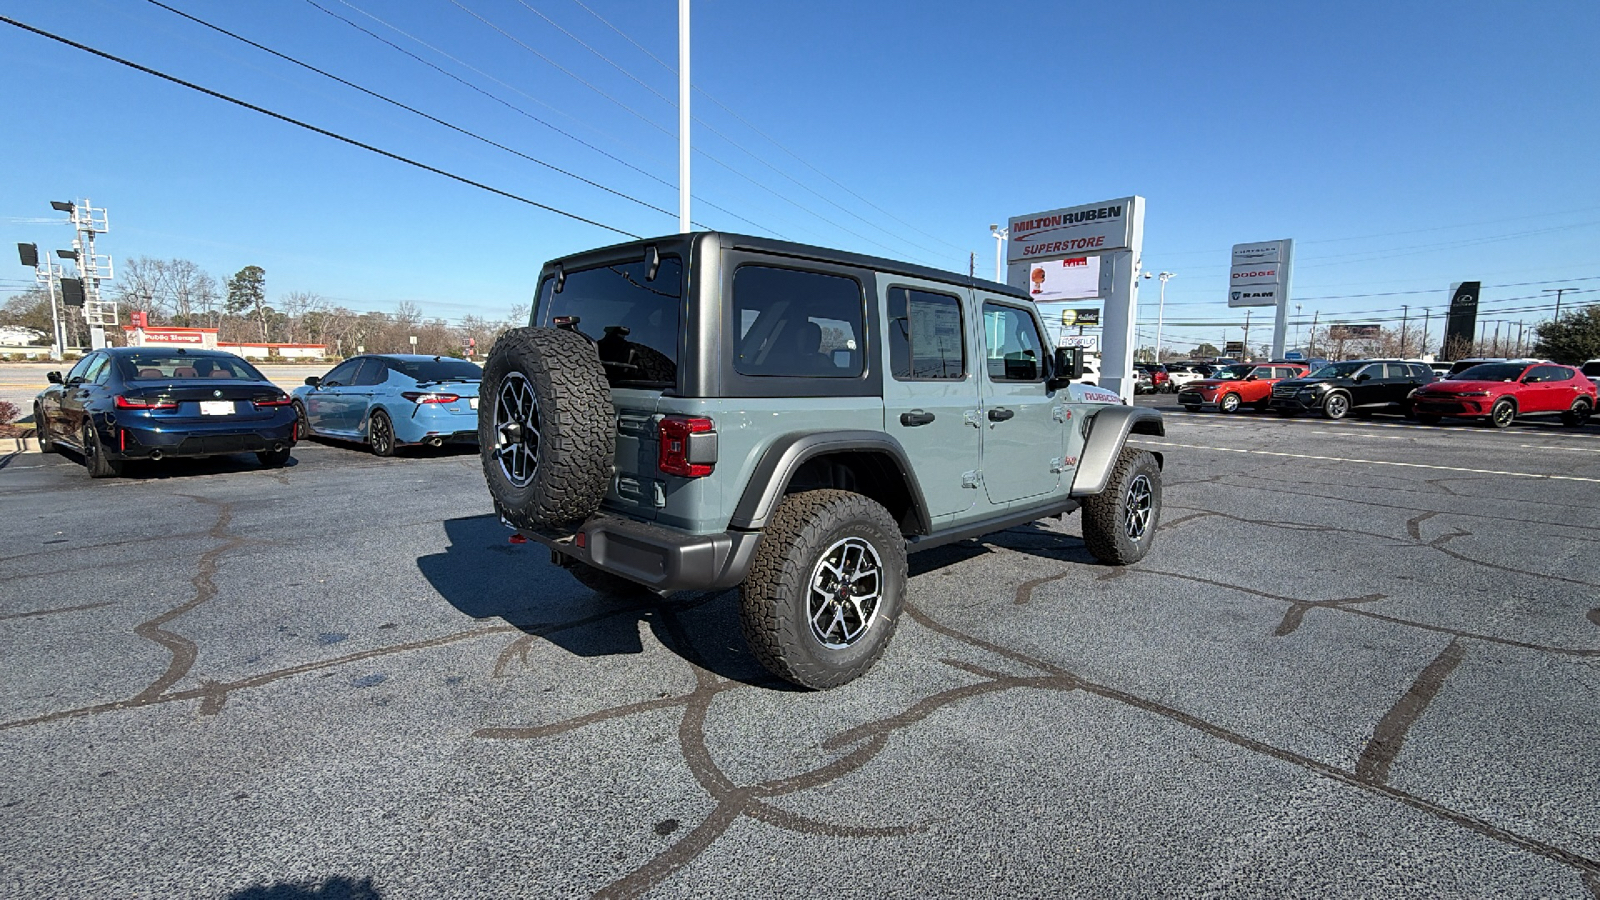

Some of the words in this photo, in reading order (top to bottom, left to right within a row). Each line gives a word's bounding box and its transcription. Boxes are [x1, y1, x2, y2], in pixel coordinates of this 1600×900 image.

[1022, 235, 1106, 256] SUPERSTORE
[1232, 270, 1275, 278] DODGE
[1084, 392, 1121, 403] RUBICON
